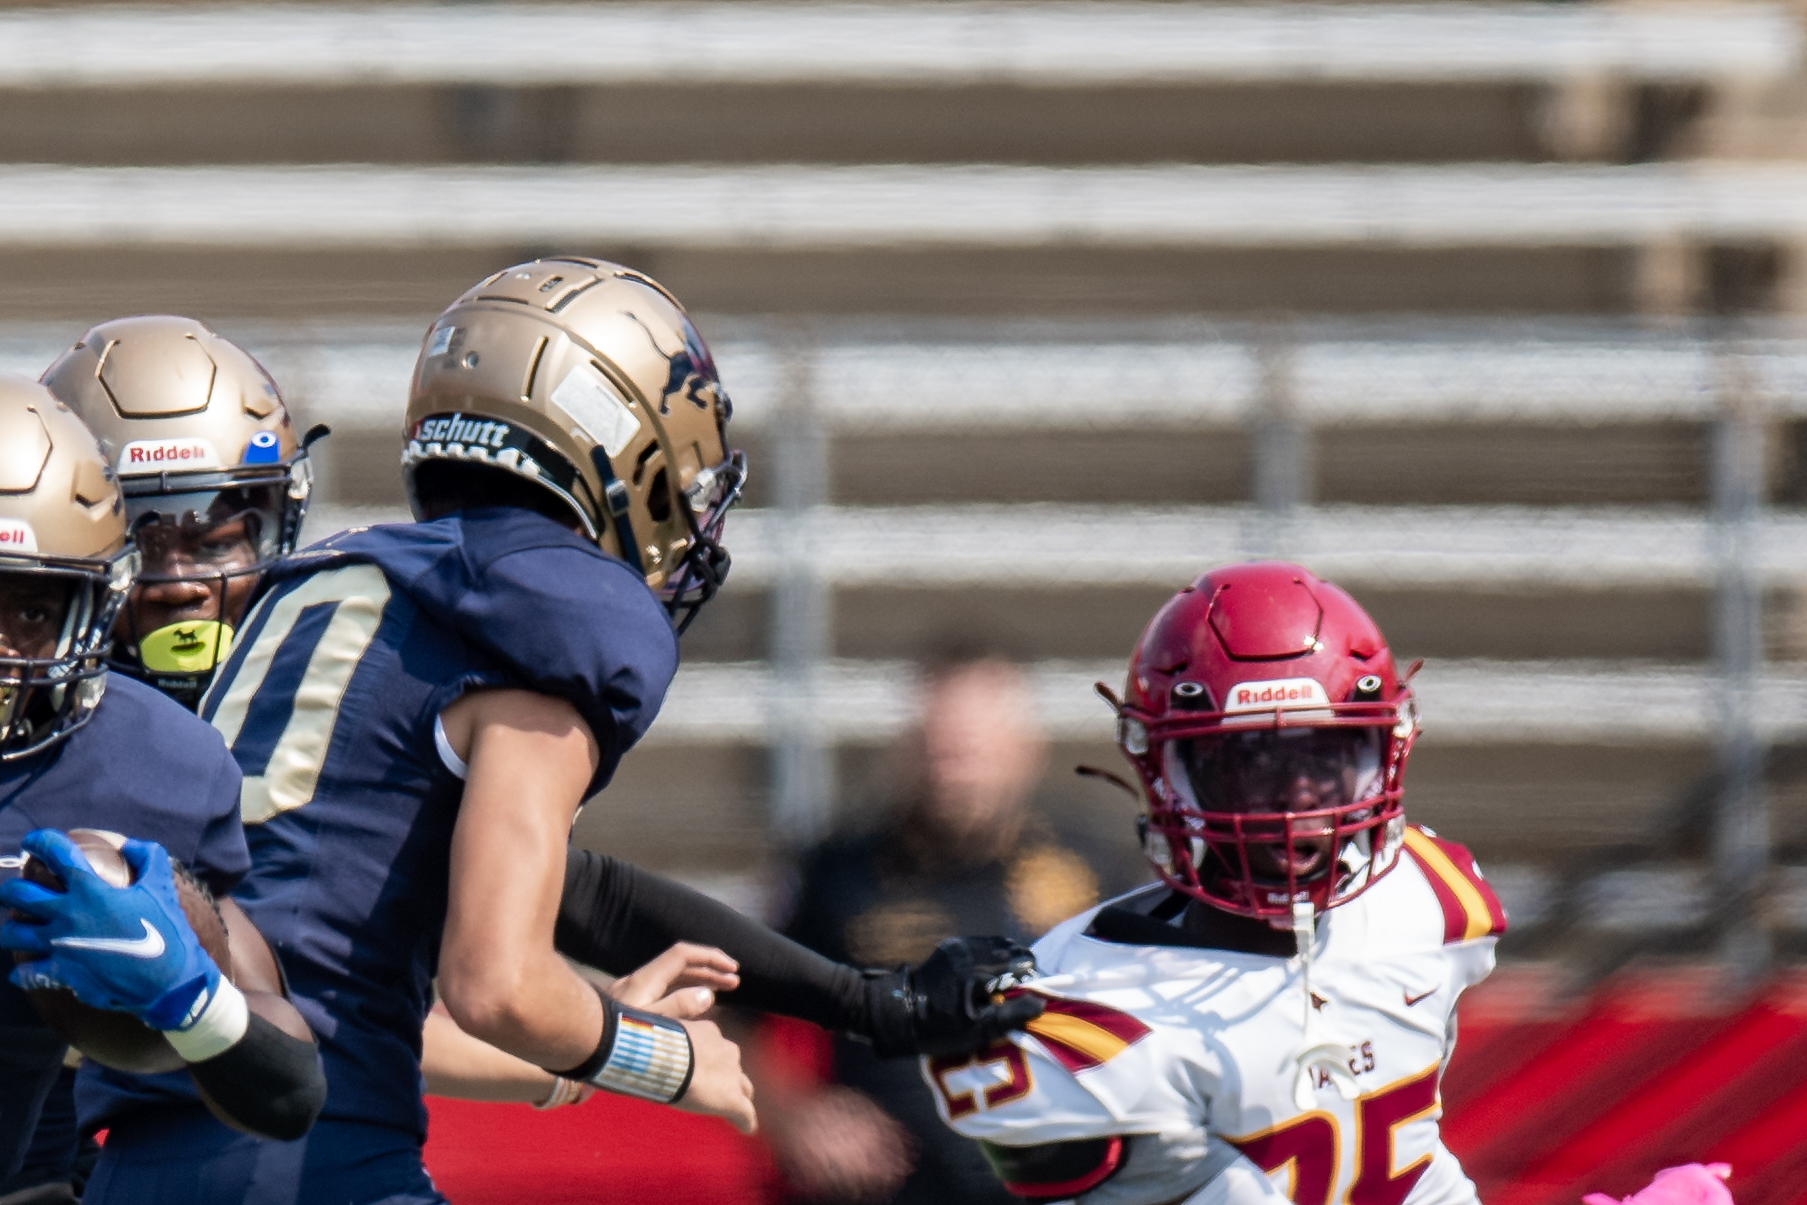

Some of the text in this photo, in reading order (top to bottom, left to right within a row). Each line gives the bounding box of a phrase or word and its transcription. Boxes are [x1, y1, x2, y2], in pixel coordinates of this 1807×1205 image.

[419, 412, 511, 448] schutt
[129, 446, 206, 463] Riddell
[1237, 685, 1313, 704] Riddell
